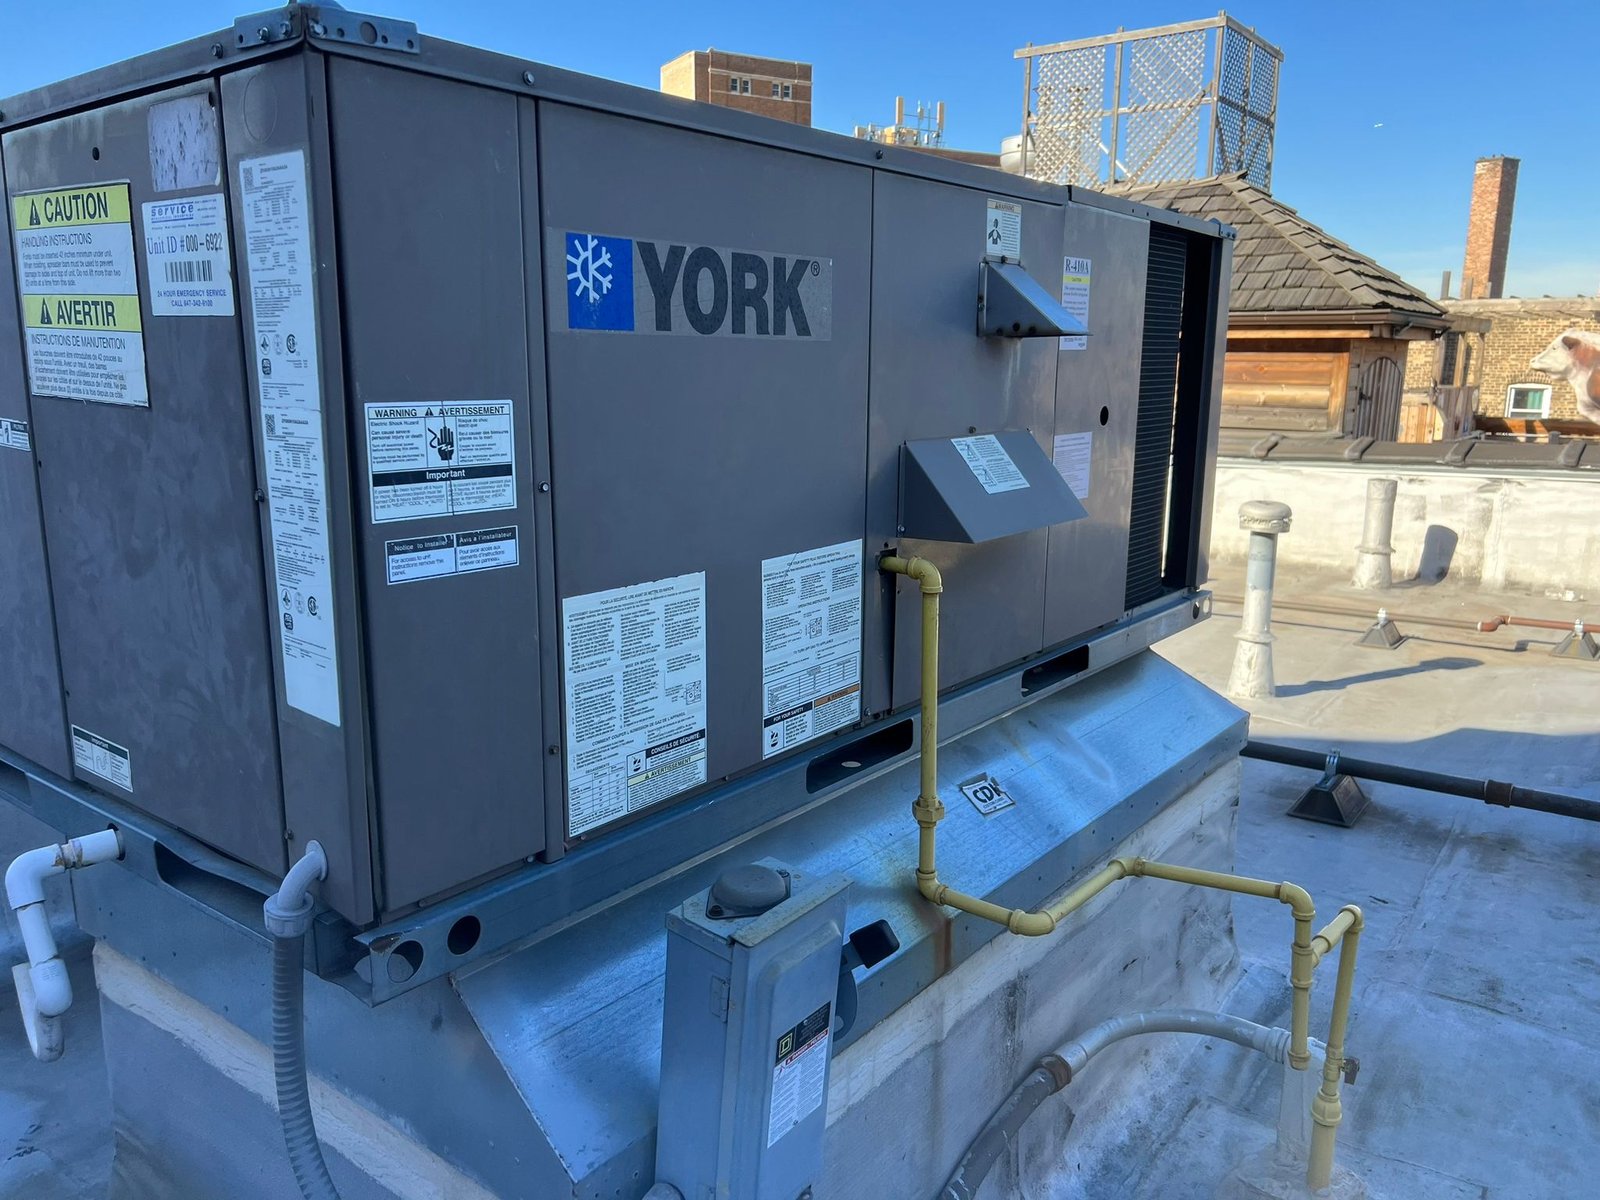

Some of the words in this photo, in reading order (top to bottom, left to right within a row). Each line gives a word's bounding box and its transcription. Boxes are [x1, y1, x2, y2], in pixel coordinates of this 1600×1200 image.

[44, 191, 109, 222] CAUTION
[151, 204, 194, 217] service
[22, 235, 48, 247] HANDLING
[50, 233, 92, 246] INSTRUCTIONS
[147, 236, 165, 254] Unit
[166, 236, 177, 254] ID
[57, 300, 116, 326] AVERTIR
[32, 334, 71, 346] INSTRUCTIONS
[73, 336, 80, 347] DE
[81, 336, 125, 349] MANUTENTION
[375, 408, 417, 417] WARNING
[439, 406, 504, 415] AVERTISSEMENT
[426, 470, 466, 480] Important
